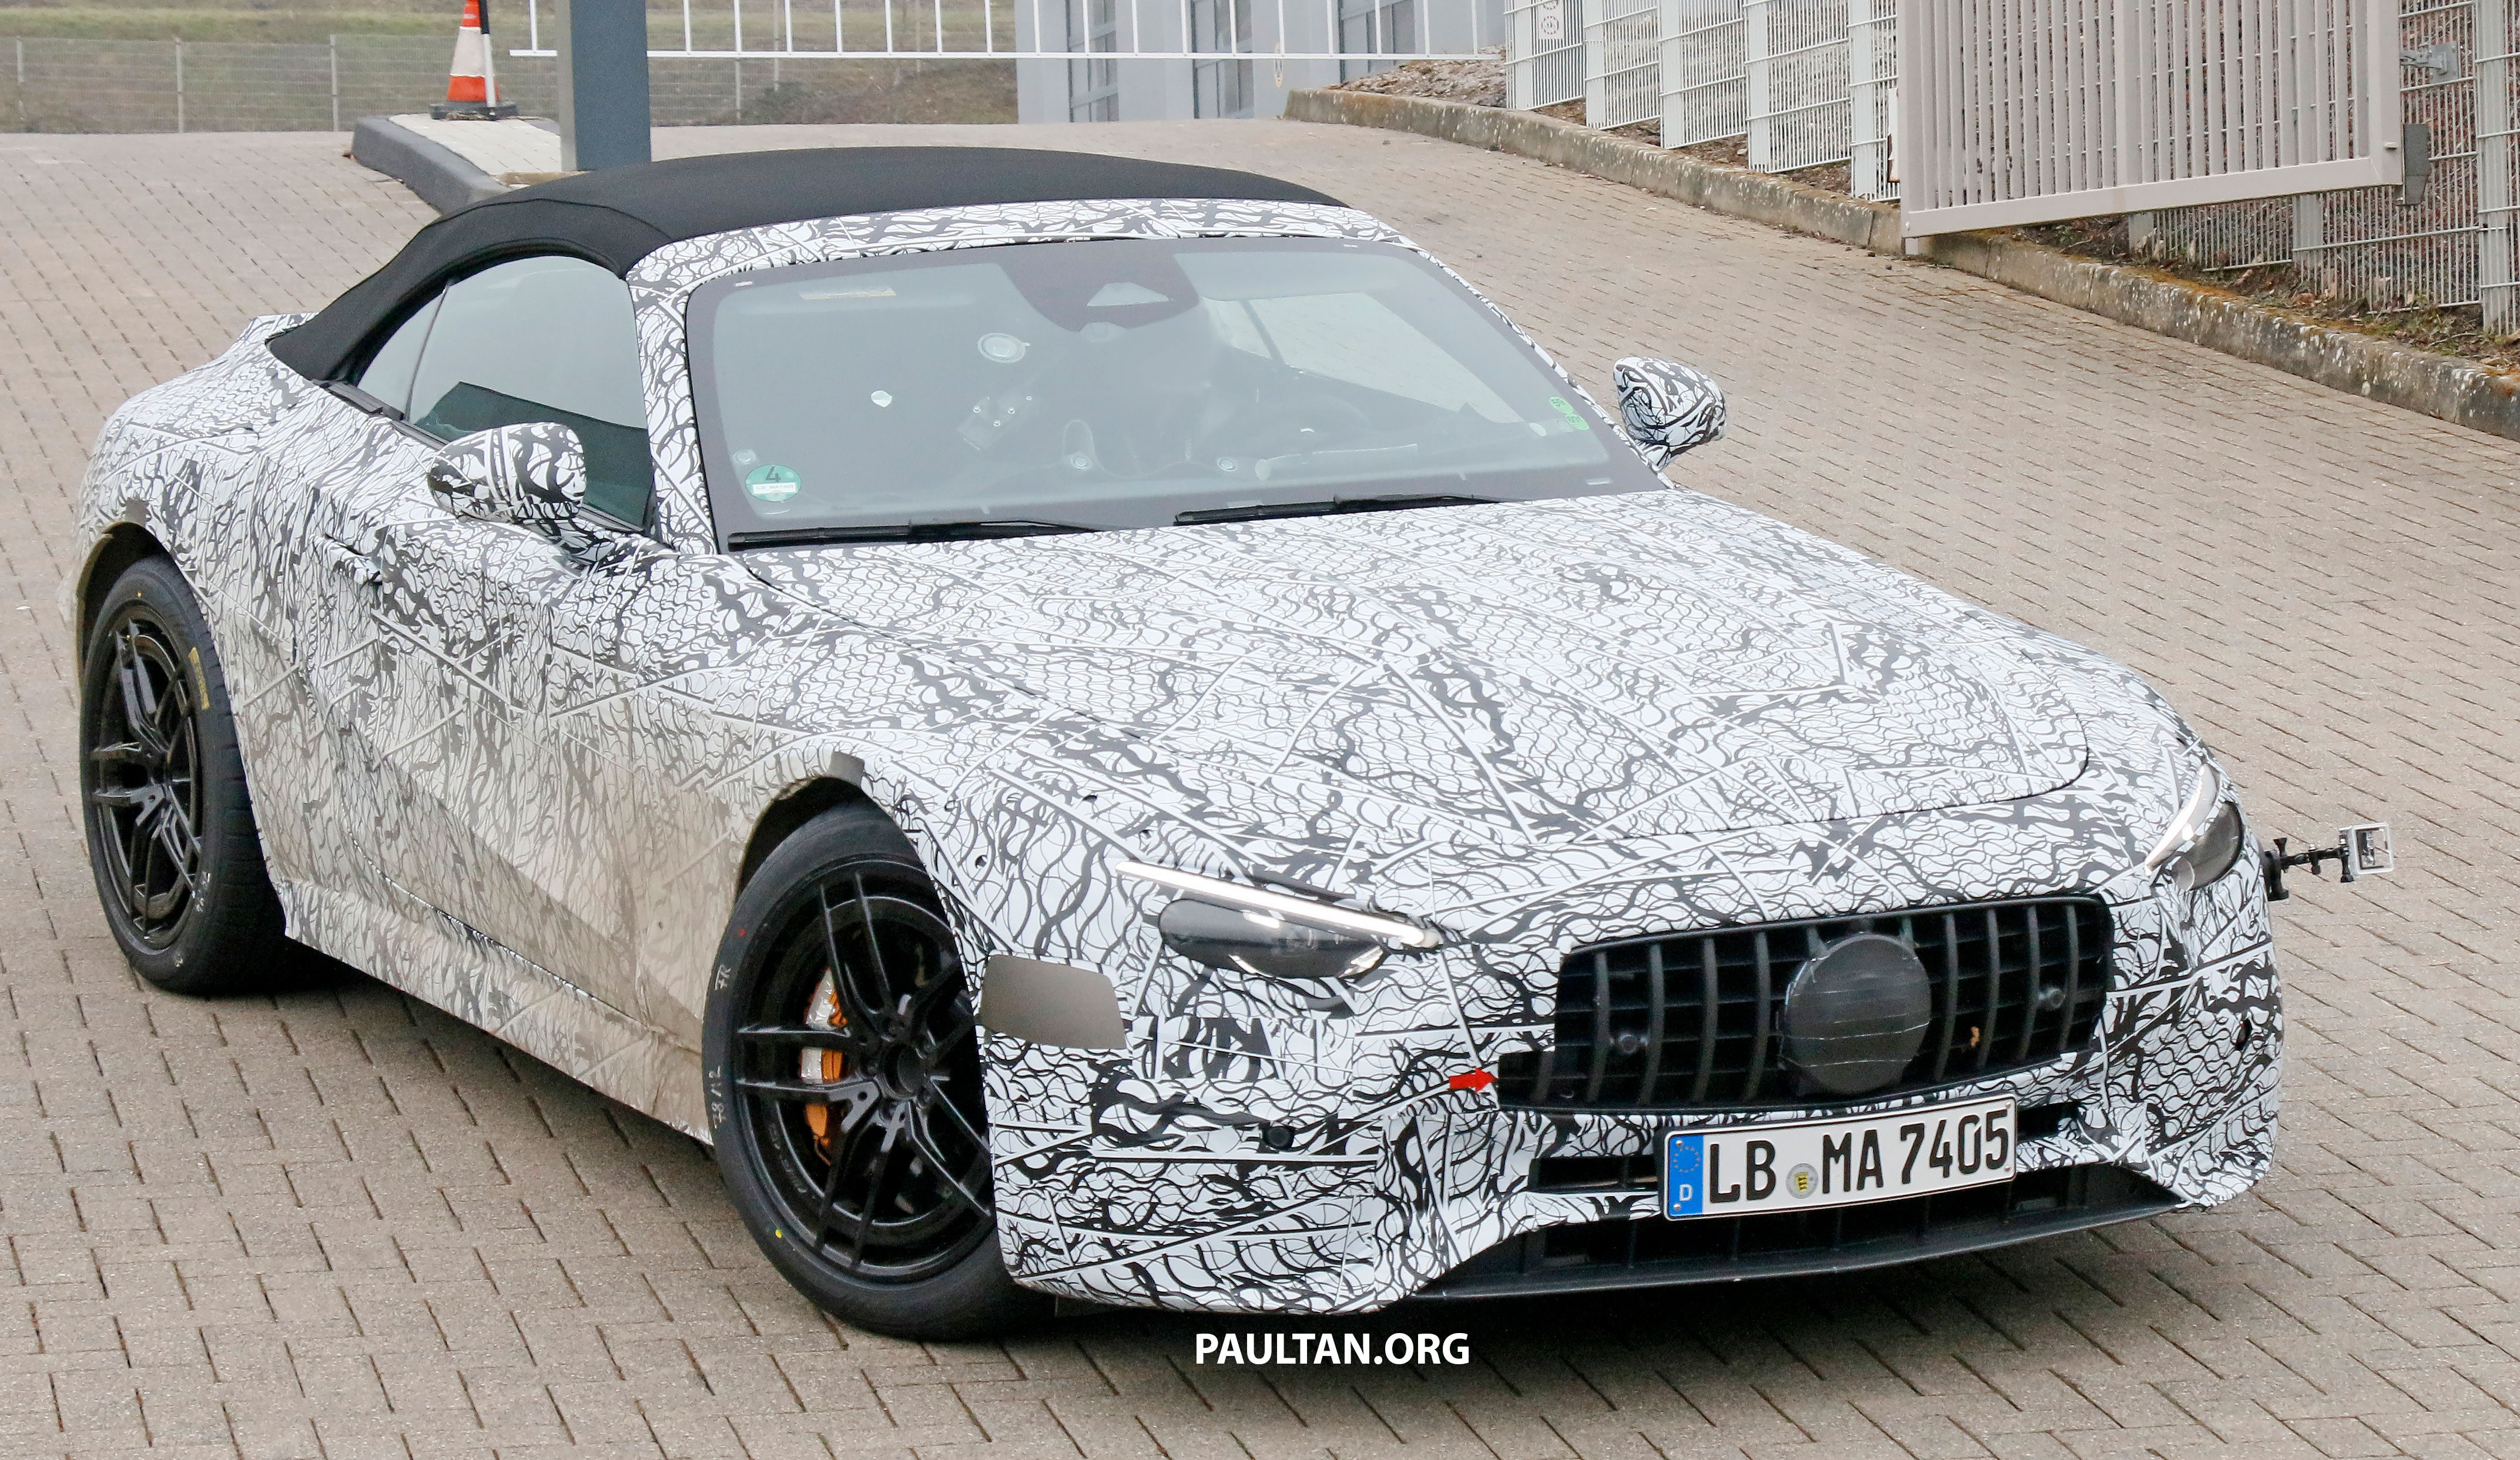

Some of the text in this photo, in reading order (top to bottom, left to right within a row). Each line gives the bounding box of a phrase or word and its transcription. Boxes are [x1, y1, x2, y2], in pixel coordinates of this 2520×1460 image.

[765, 466, 781, 481] 4
[1710, 1109, 2009, 1204] LB MA 7405
[1679, 1184, 1693, 1202] D
